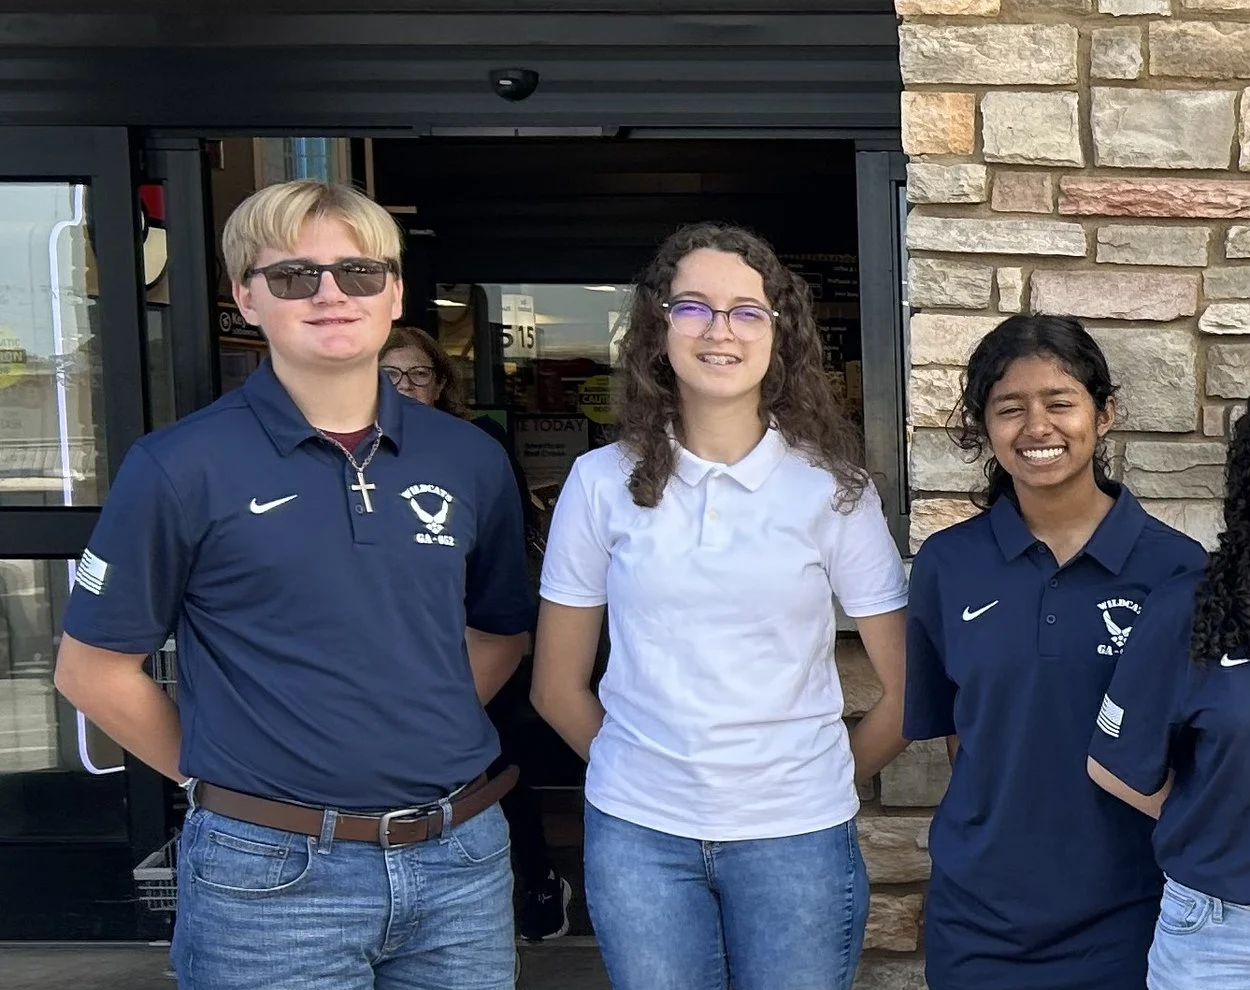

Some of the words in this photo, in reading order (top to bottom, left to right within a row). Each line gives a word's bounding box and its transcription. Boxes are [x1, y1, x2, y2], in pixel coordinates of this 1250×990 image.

[518, 325, 535, 349] 15
[532, 419, 585, 432] TODAY
[400, 484, 454, 502] WILDCATS
[1097, 598, 1142, 615] WILDCA
